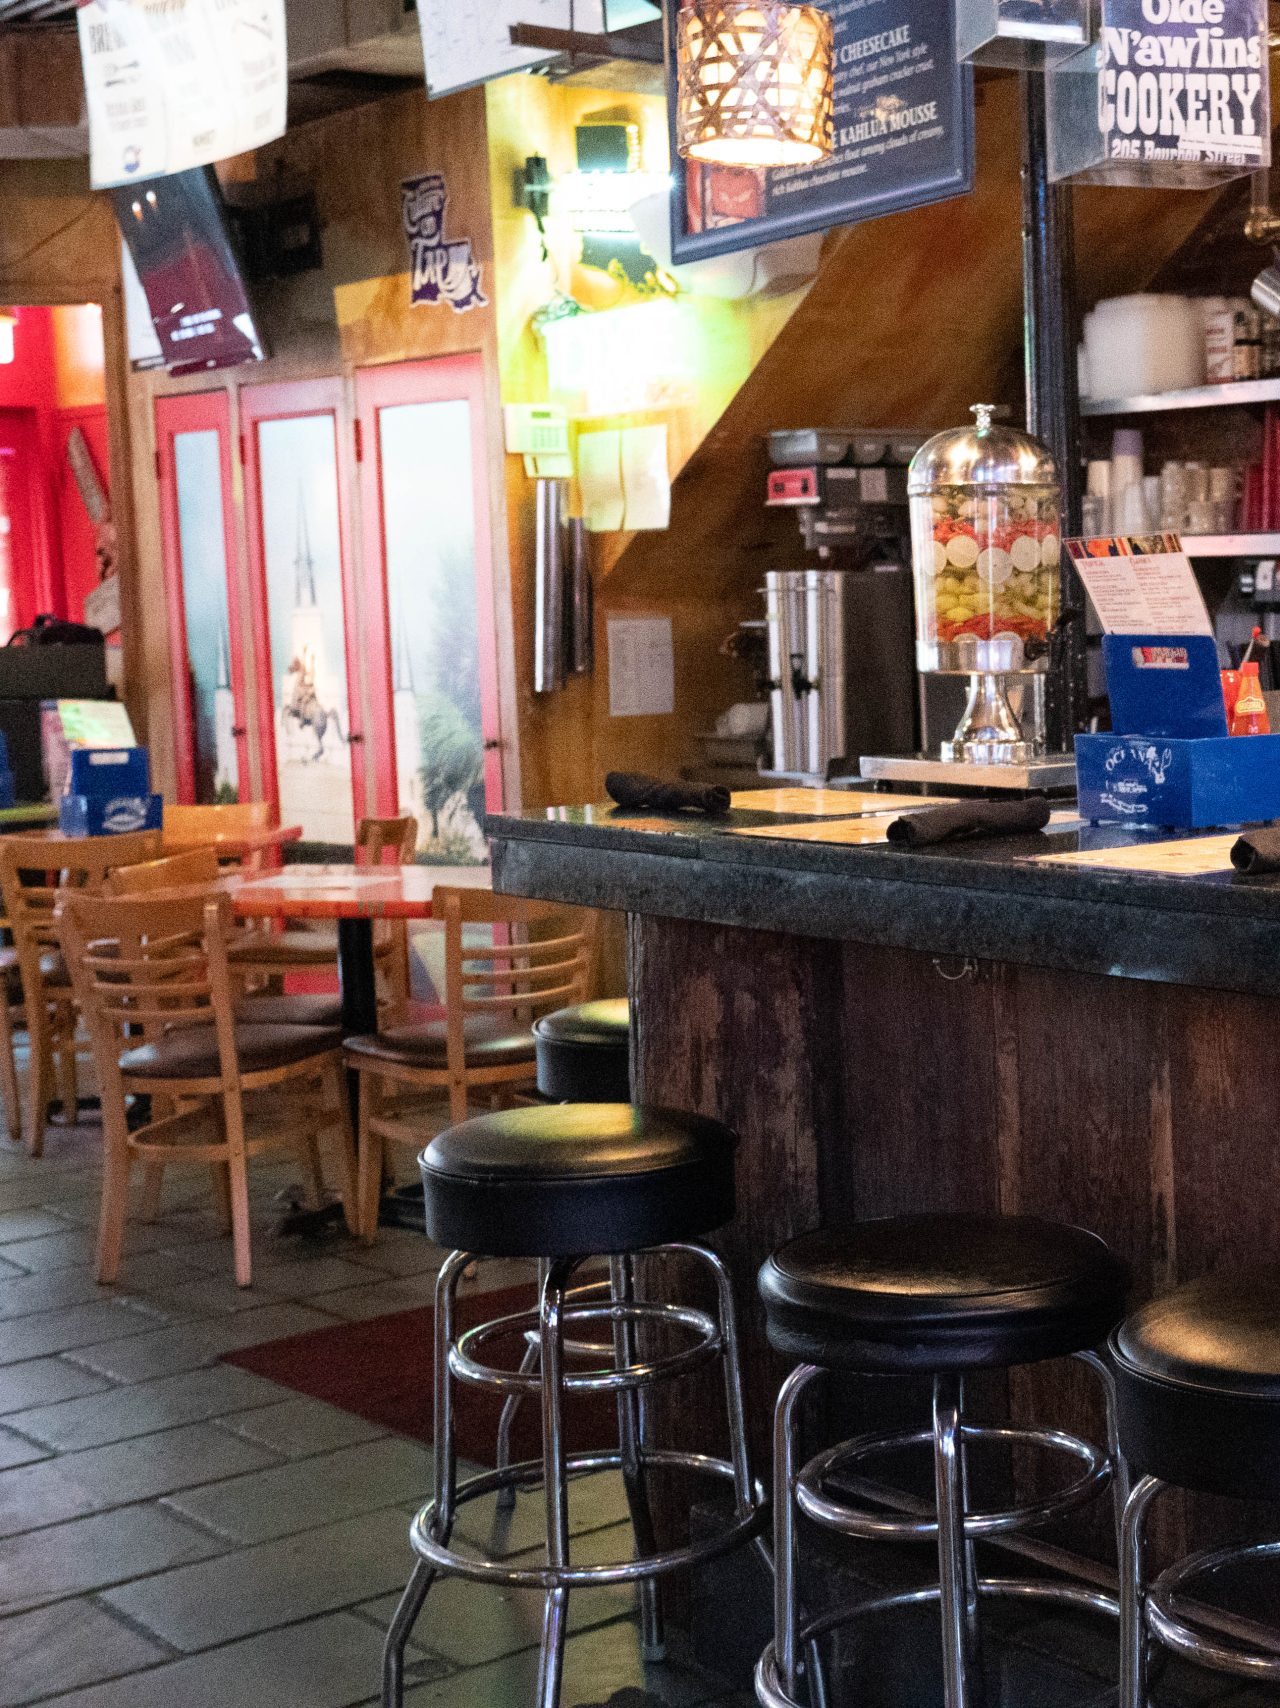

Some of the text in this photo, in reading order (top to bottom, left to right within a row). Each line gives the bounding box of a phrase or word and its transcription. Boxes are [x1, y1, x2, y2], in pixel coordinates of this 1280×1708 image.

[1141, 0, 1225, 24] Olde
[841, 24, 910, 64] CHEESECAKE
[1095, 27, 1261, 68] N'awlins
[1097, 69, 1261, 135] COOKERY
[840, 119, 887, 146] KAHLUA
[889, 101, 938, 131] MOUSSE
[1111, 138, 1141, 159] 205
